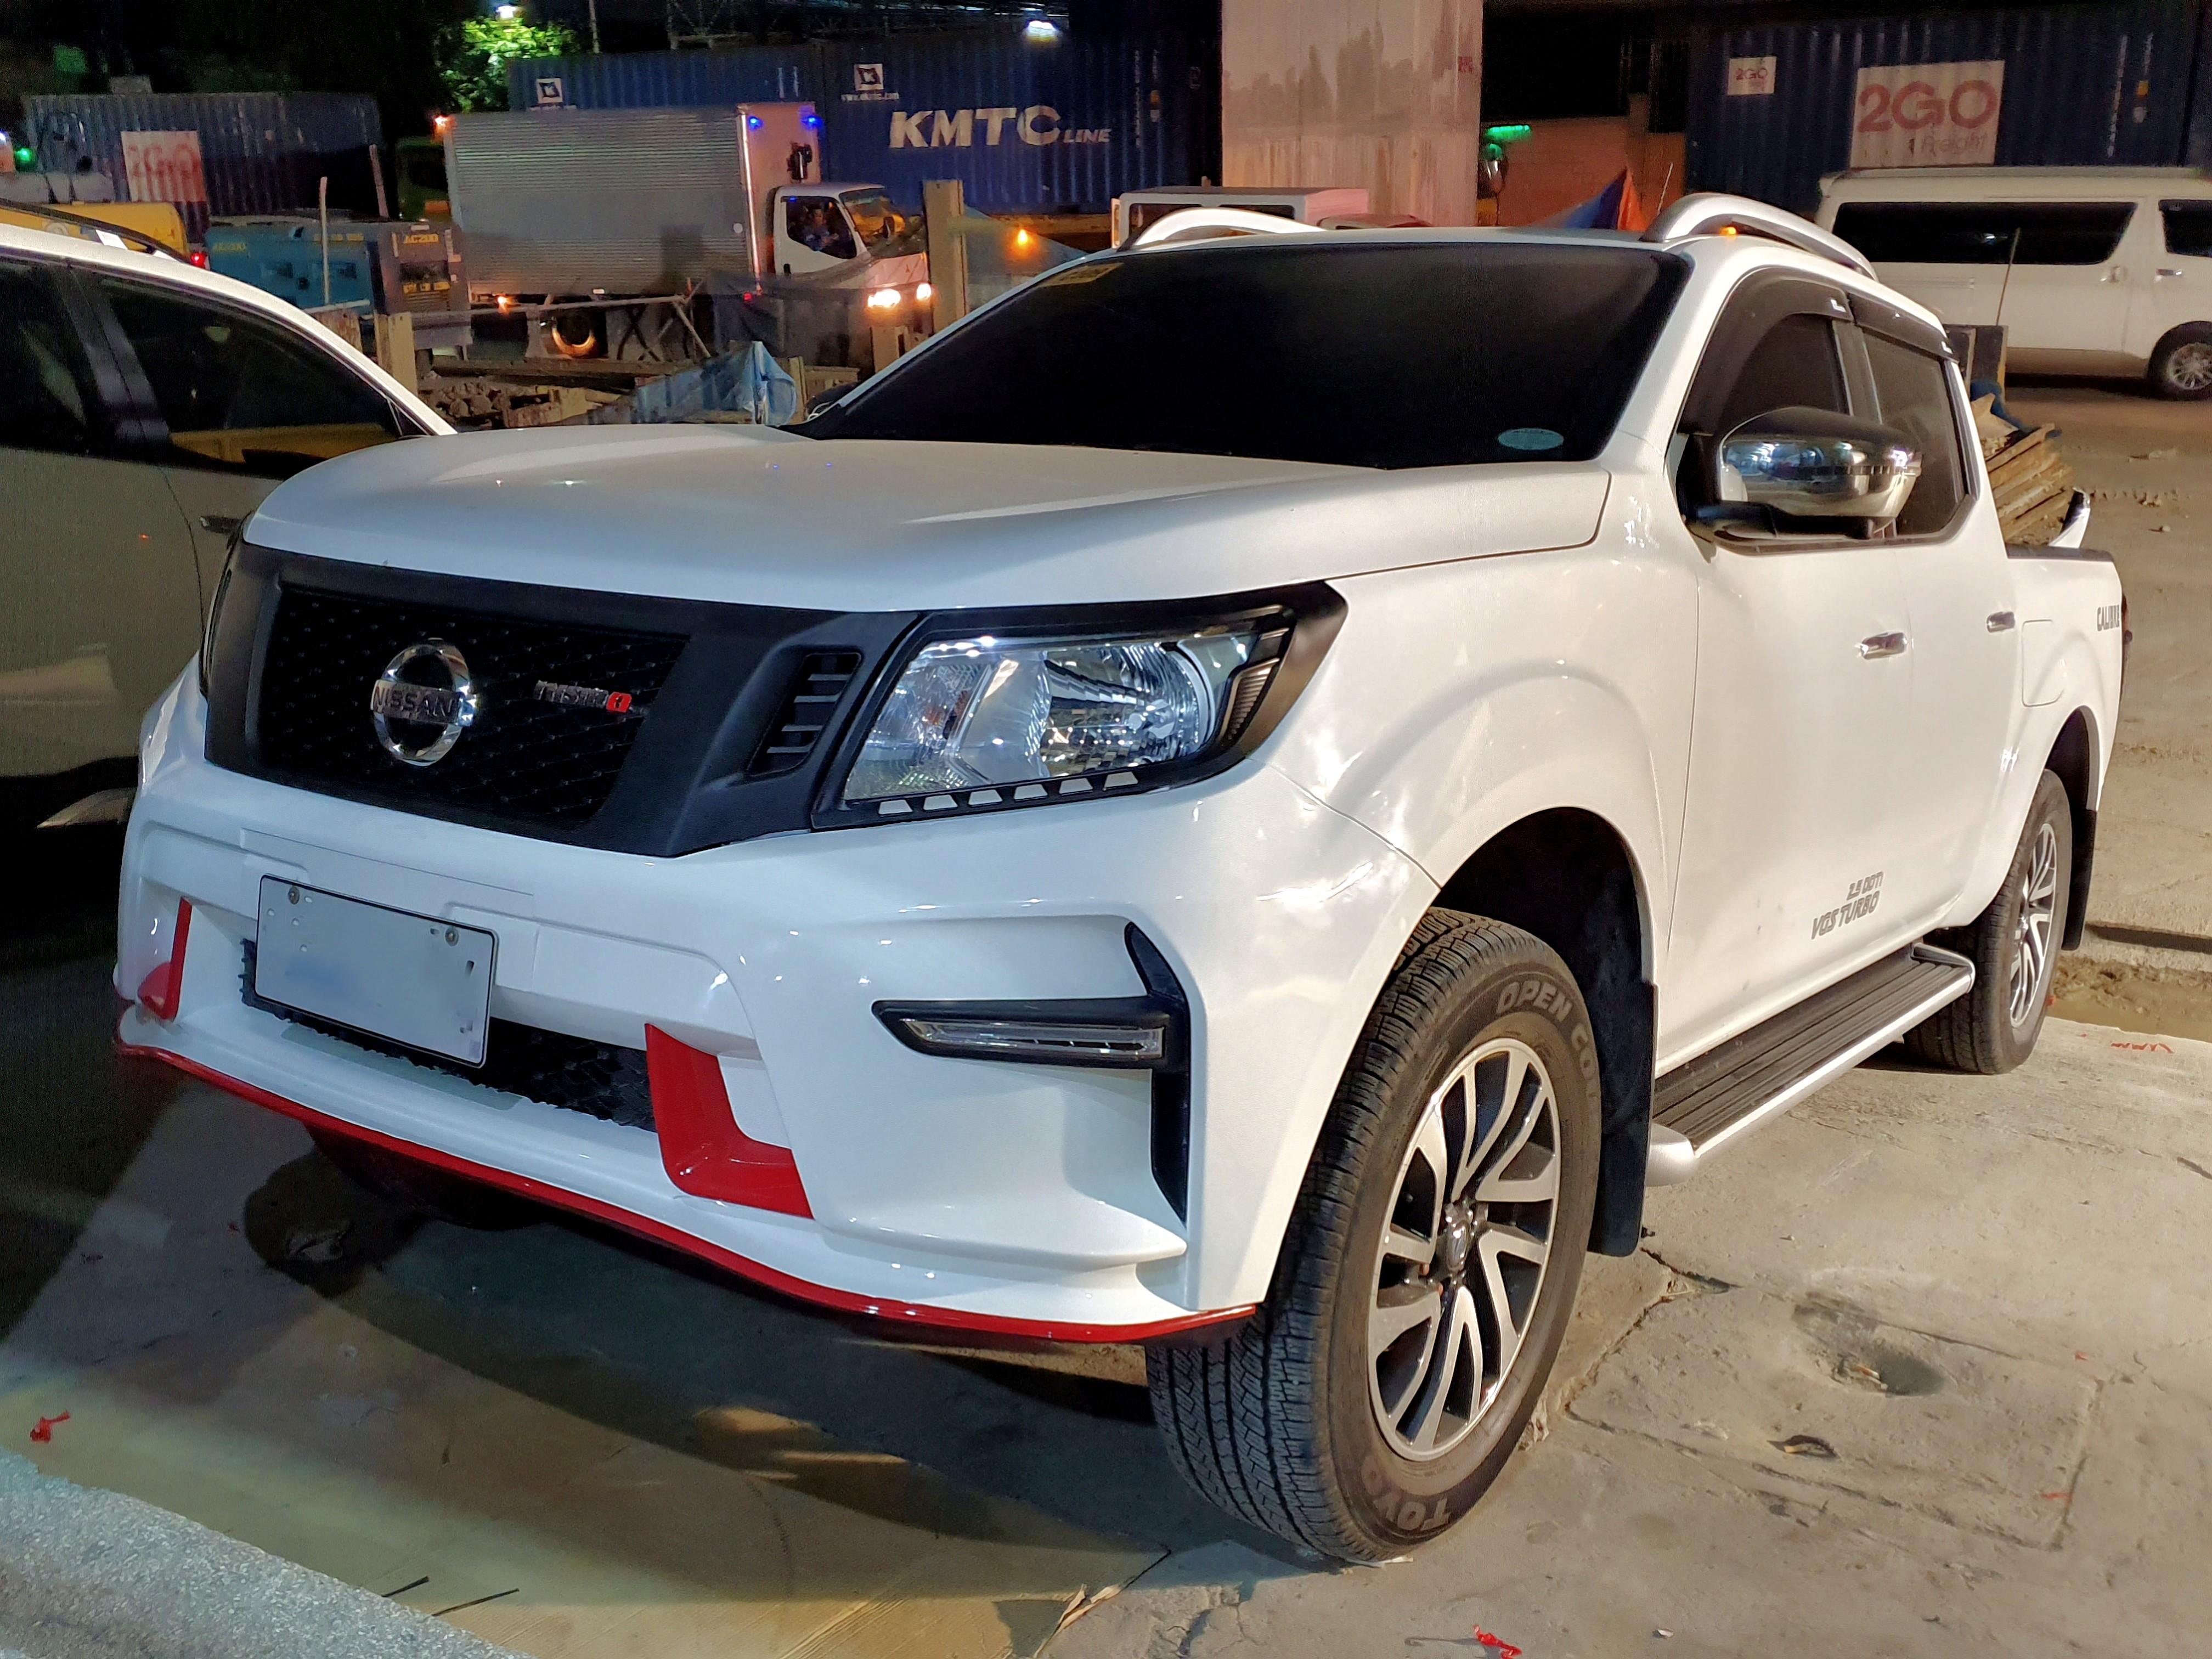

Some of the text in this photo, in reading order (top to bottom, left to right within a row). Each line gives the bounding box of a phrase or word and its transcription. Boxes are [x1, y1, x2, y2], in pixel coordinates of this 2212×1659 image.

[1736, 67, 1768, 80] 2GO
[889, 105, 1112, 148] KMTC LINE
[1857, 80, 1997, 132] 2GO
[374, 686, 456, 717] NISSAN
[1811, 890, 1880, 940] VGS TURBO
[1496, 980, 1573, 1022] OPEN
